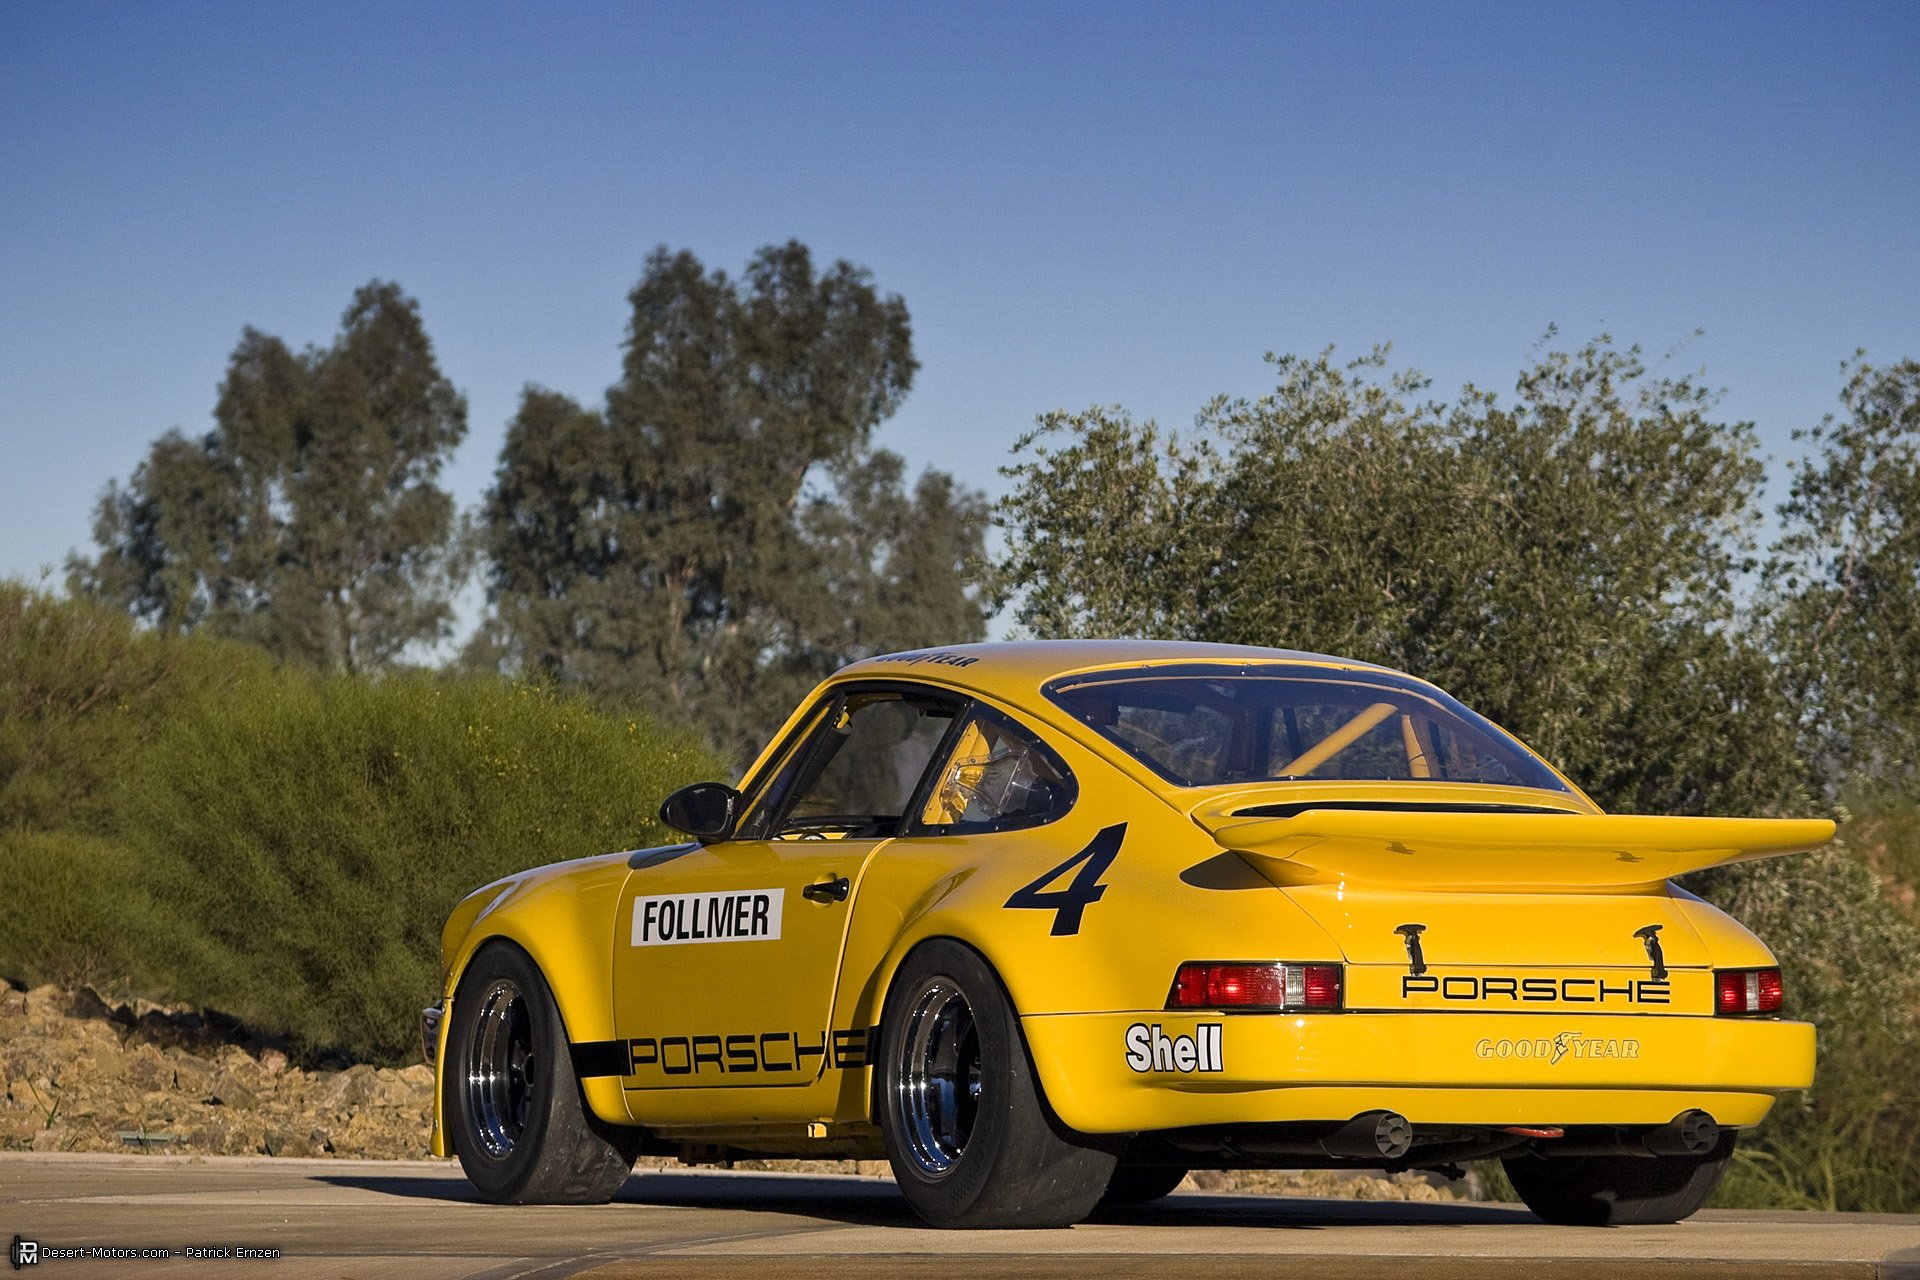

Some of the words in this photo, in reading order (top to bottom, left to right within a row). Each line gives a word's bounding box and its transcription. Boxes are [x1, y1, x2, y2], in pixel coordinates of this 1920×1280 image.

[1002, 821, 1128, 936] 4
[642, 894, 770, 942] FOLLMER
[1402, 975, 1671, 1004] PORSCHE
[628, 1029, 867, 1076] PORSCHE
[1125, 1022, 1224, 1073] Shell
